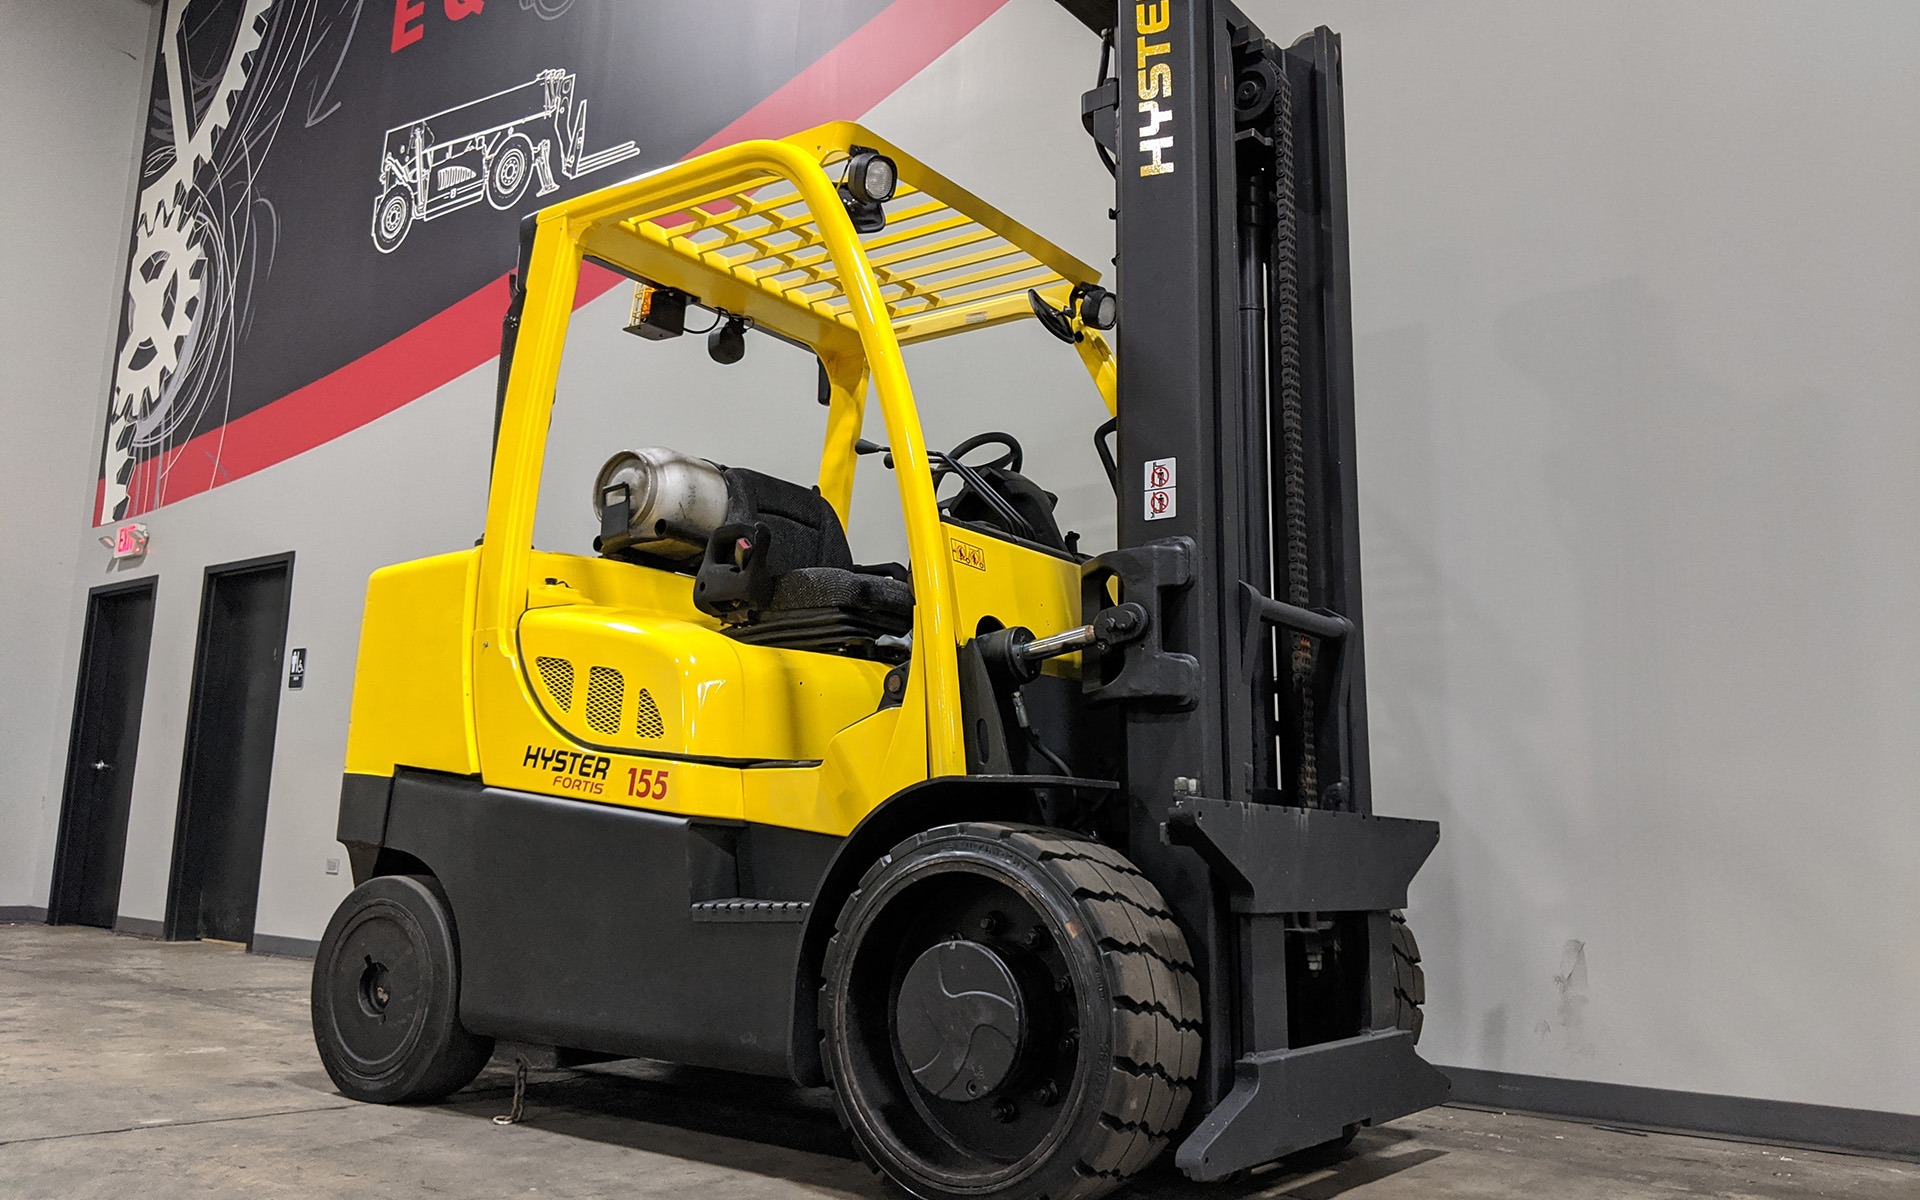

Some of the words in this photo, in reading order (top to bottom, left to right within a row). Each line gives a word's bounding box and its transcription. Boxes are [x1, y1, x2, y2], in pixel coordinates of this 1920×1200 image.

[1136, 0, 1174, 177] HYSTE
[523, 745, 611, 780] HYSTER
[627, 767, 669, 800] 155
[553, 775, 605, 795] FORTIS
